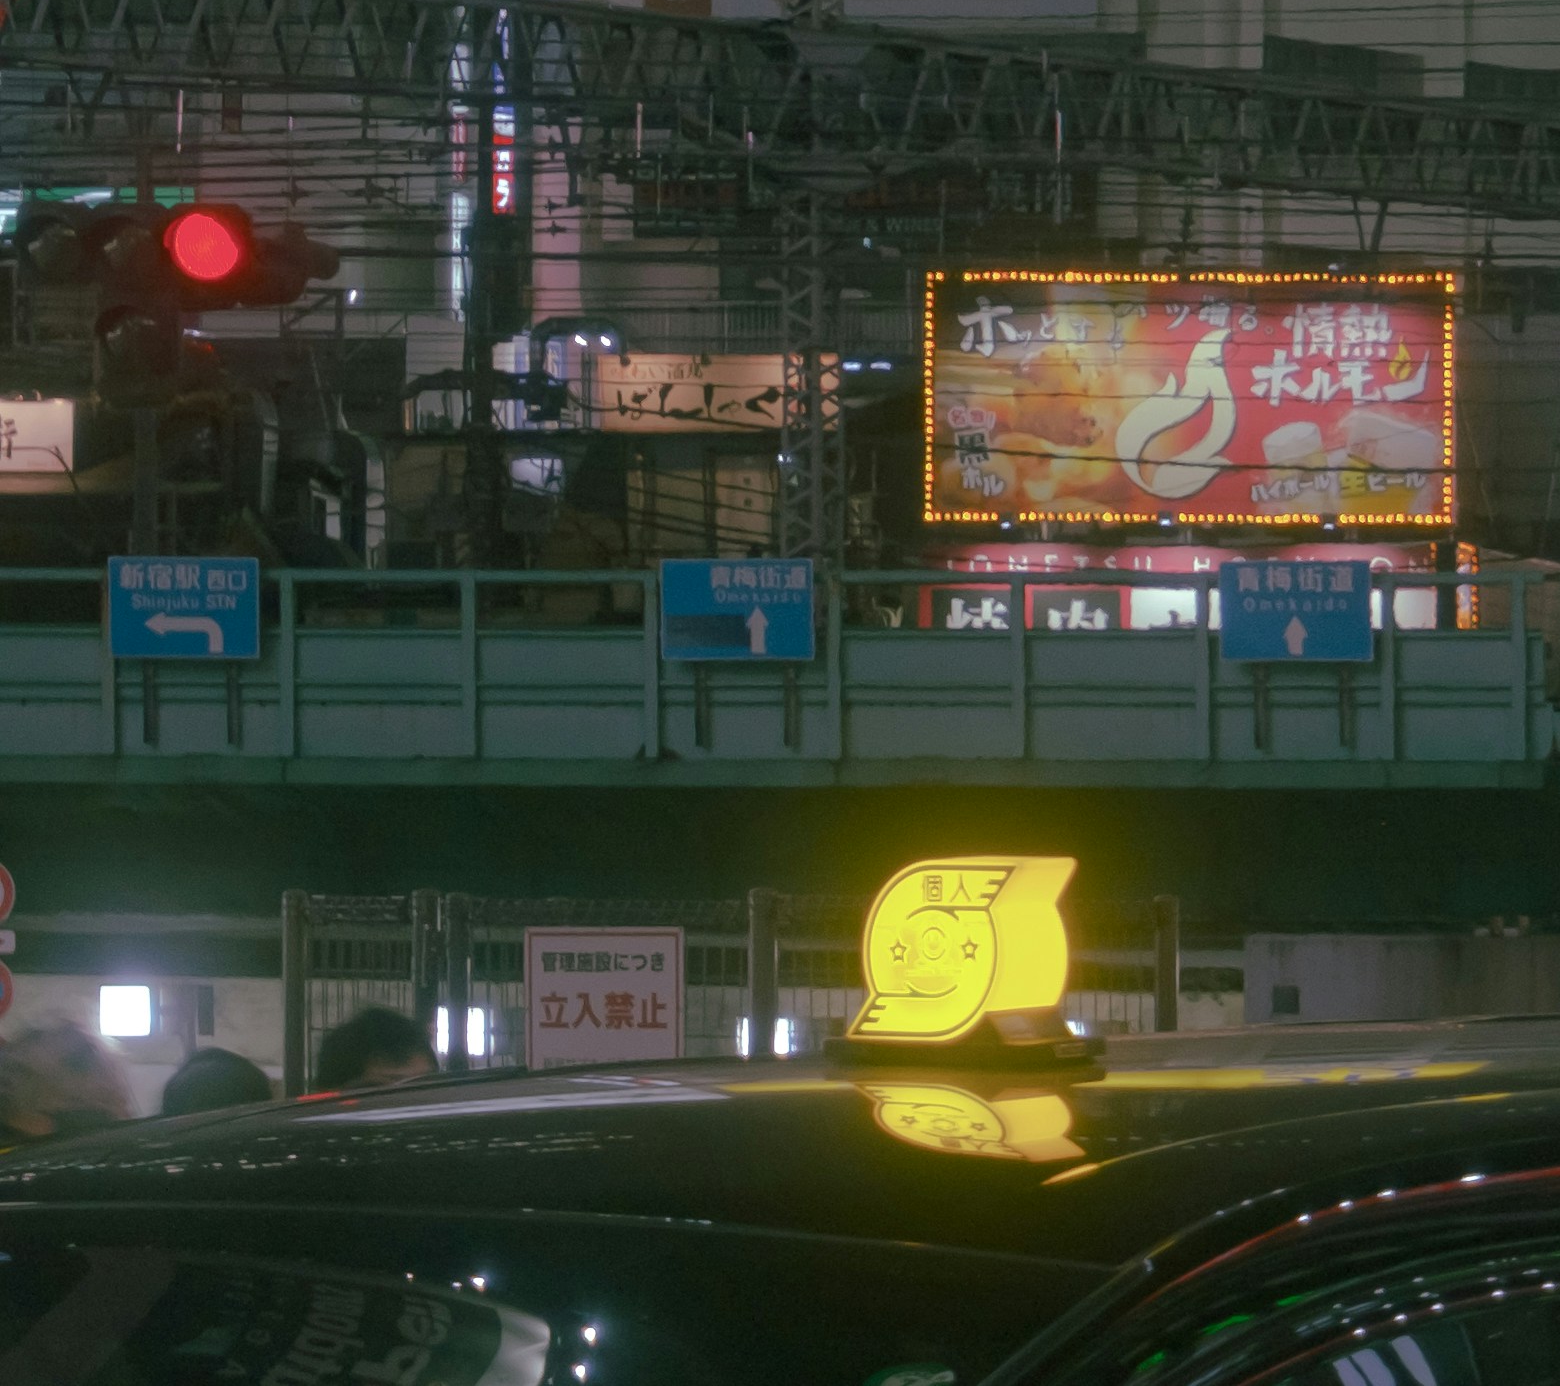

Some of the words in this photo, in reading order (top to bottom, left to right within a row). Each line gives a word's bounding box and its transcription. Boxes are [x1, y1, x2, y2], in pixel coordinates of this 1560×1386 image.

[1282, 302, 1392, 358] 情熱
[1250, 348, 1430, 407] ホルモン
[922, 874, 971, 903] 個人
[540, 951, 666, 973] 管理施設につき
[538, 990, 668, 1030] 立入禁止
